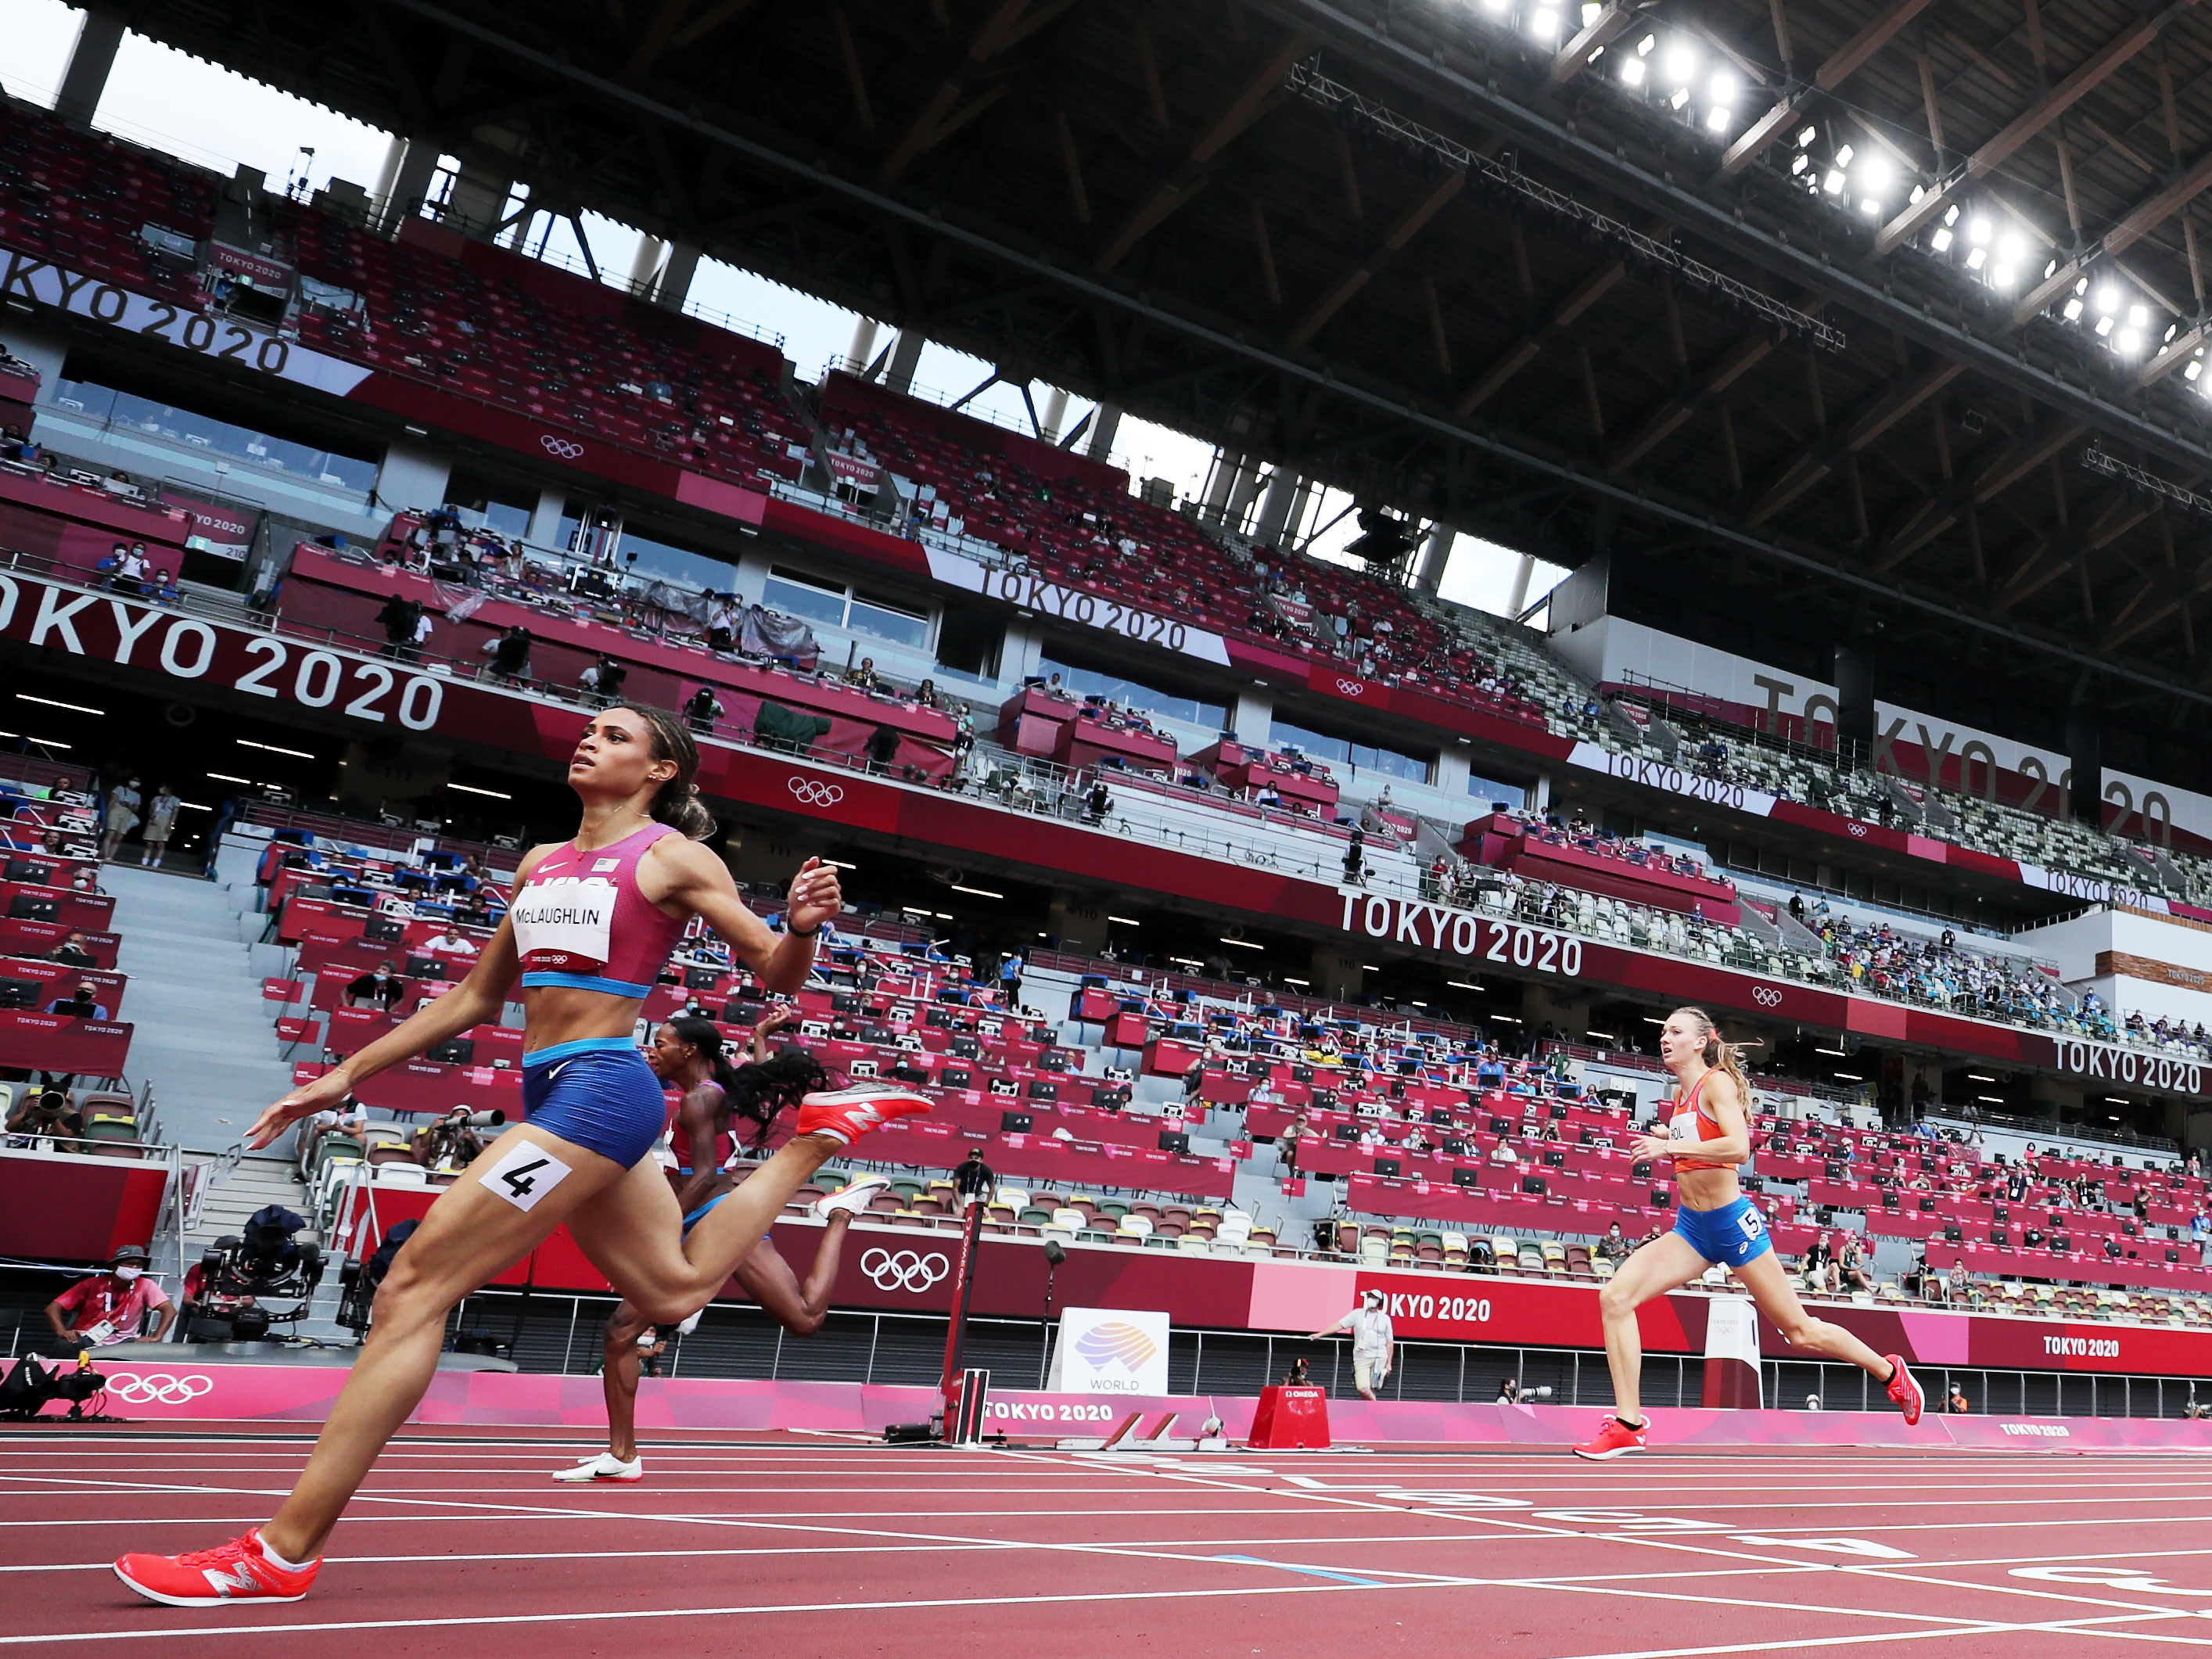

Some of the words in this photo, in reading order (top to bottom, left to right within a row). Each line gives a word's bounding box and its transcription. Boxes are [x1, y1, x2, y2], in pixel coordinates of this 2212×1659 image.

[220, 252, 254, 270] TOKYO
[255, 265, 282, 279] 2020
[141, 302, 289, 375] 2020
[831, 458, 855, 472] TOKYO
[856, 468, 874, 478] 2020
[213, 519, 246, 535] 2020
[979, 562, 1095, 623] TOKYO
[1104, 603, 1186, 652] 2020
[235, 637, 443, 731] 2020
[1606, 749, 1682, 793] TOKYO
[1689, 775, 1745, 810] 2020
[2045, 867, 2102, 900] TOKYO
[515, 907, 599, 925] McLAUGHLIN
[1338, 887, 1478, 956] TOKYO
[1486, 922, 1582, 976] 2020
[2052, 1037, 2136, 1083] TOKYO
[2142, 1058, 2201, 1094] 2020
[501, 1158, 551, 1198] 4
[1744, 1213, 1759, 1233] 5
[957, 1236, 970, 1291] OMEGA
[1437, 1296, 1491, 1322] 2020
[2043, 1336, 2087, 1356] TOKYO
[2088, 1339, 2120, 1357] 2020
[1090, 1379, 1140, 1391] WORLD
[985, 1402, 1054, 1421] TOKYO
[1058, 1404, 1113, 1421] 2020
[1999, 1424, 2041, 1436] TOKYO
[2039, 1425, 2070, 1437] 2020
[1726, 1535, 1919, 1558] 4
